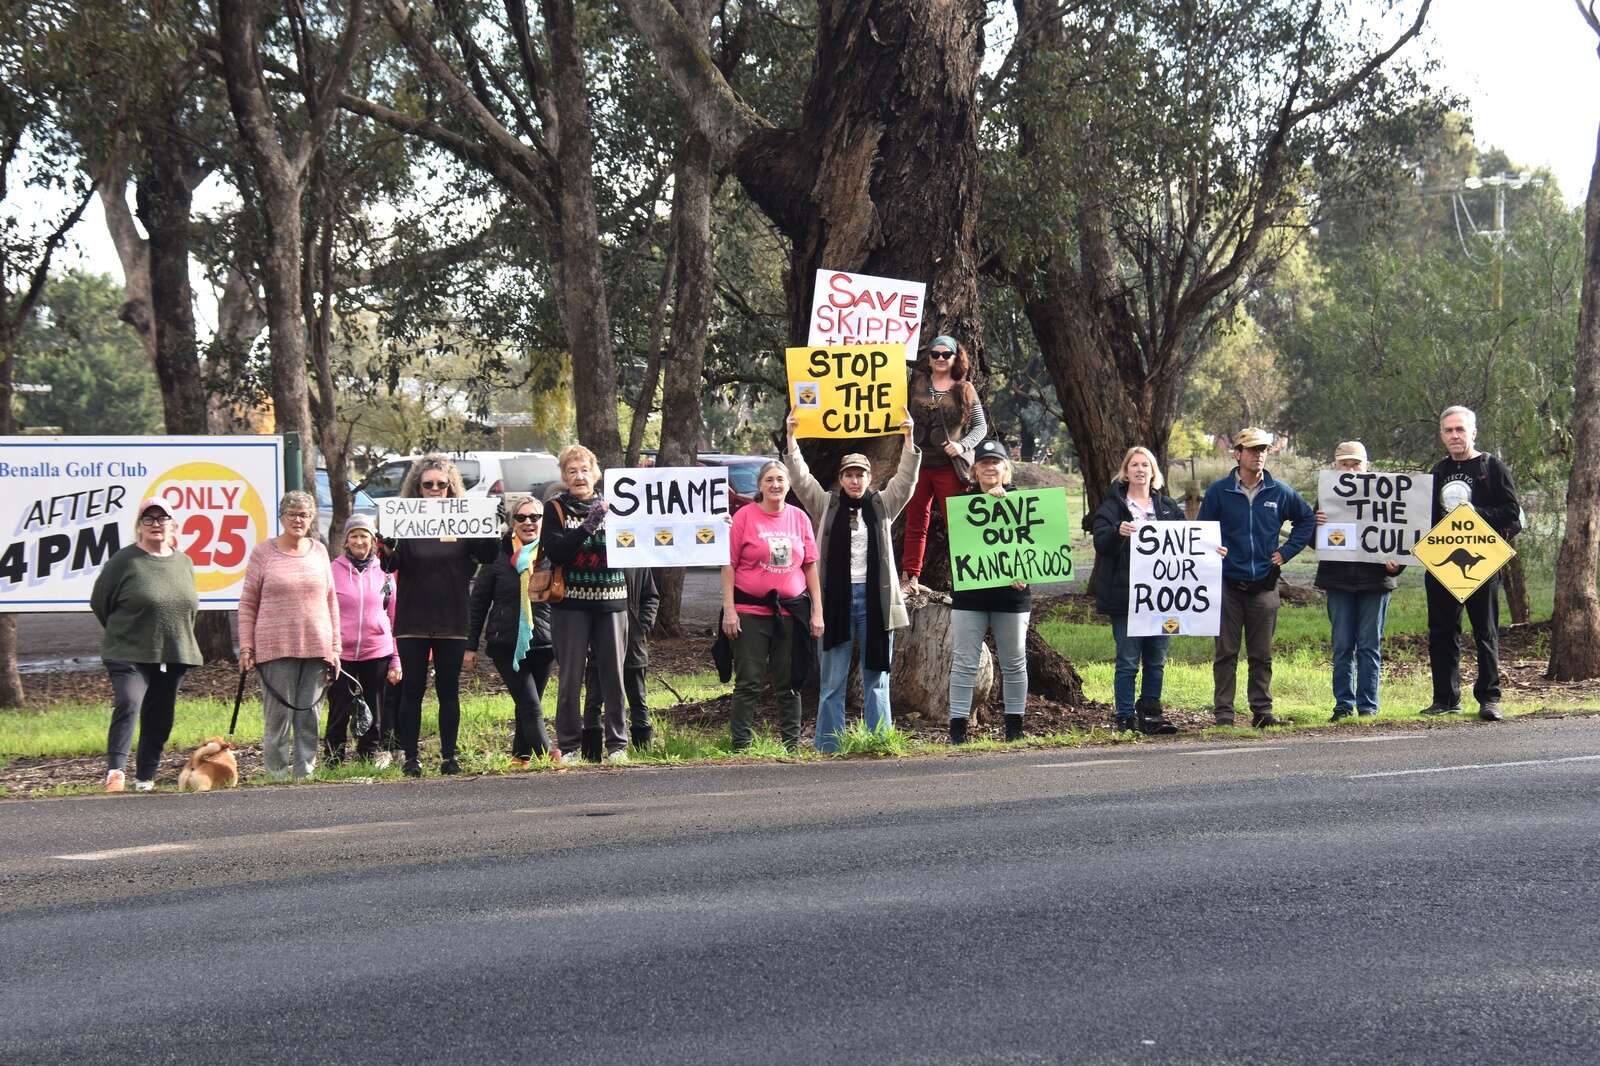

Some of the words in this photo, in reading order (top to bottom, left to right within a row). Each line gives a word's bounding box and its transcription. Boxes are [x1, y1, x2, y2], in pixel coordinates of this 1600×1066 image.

[828, 273, 919, 318] SAVE
[816, 304, 919, 343] SKIPPY
[807, 350, 888, 381] STOP
[835, 382, 892, 412] THE
[822, 409, 901, 434] CULL
[0, 462, 60, 477] Benalla
[66, 462, 103, 477] Golf
[107, 462, 147, 477] Club
[162, 486, 240, 510] ONLY
[608, 477, 727, 516] SHAME
[1333, 473, 1412, 500] STOP
[24, 485, 126, 530] AFTER
[385, 499, 427, 515] SAVE
[437, 499, 469, 514] THE
[966, 496, 1044, 527] SAVE
[1346, 499, 1407, 524] THE
[393, 516, 500, 537] KANGAROOS!
[983, 525, 1035, 545] OUR
[1427, 535, 1497, 545] SHOOTING
[1451, 521, 1475, 531] NO
[168, 514, 249, 567] 25
[1136, 525, 1206, 556] SAVE
[955, 544, 1072, 581] KANGAROOS
[1153, 558, 1198, 581] OUR
[1134, 583, 1210, 614] ROOS
